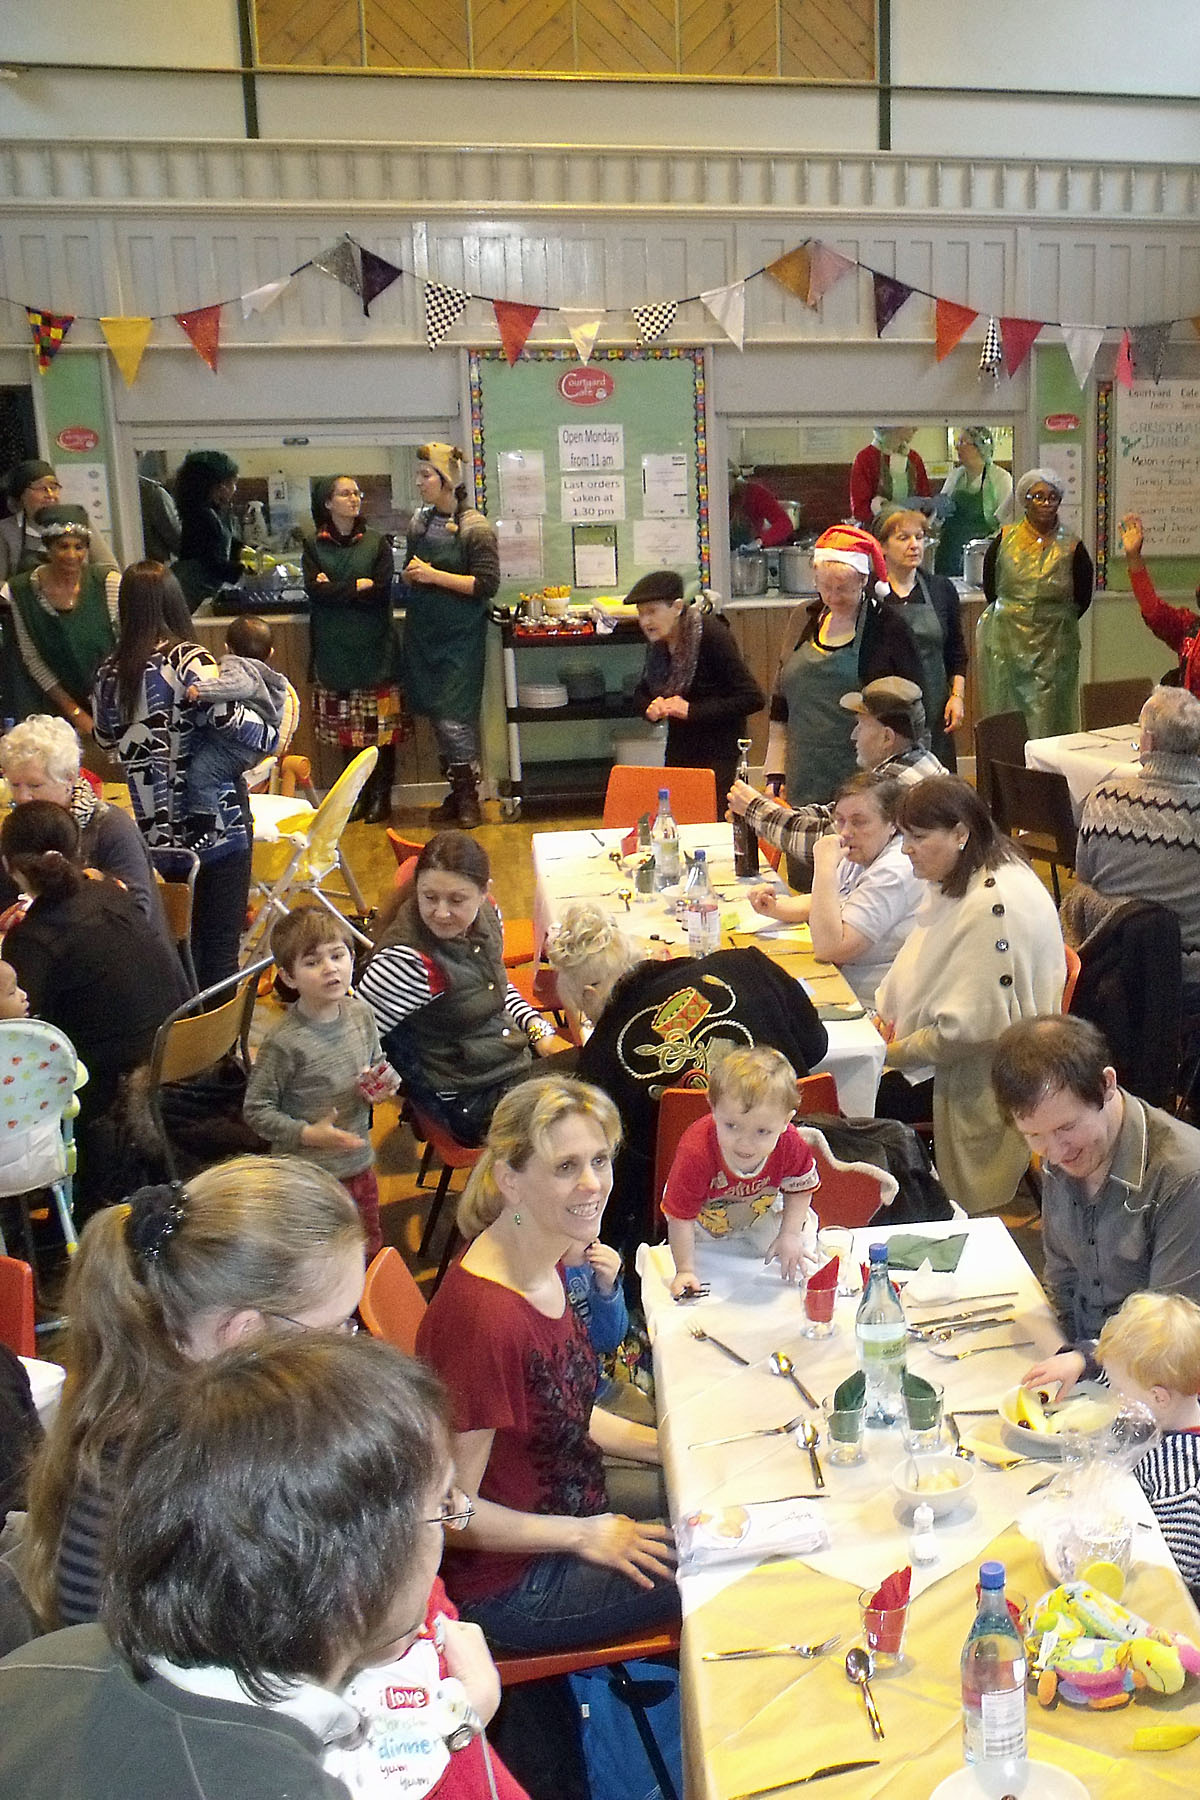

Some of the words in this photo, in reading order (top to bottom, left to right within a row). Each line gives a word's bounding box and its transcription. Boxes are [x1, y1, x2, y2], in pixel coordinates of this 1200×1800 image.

[561, 373, 606, 395] Courtyard
[562, 429, 583, 445] Open
[584, 428, 620, 446] Mondays
[570, 452, 589, 467] from
[591, 453, 600, 467] 11
[602, 455, 614, 467] am
[563, 480, 584, 489] Last
[587, 480, 621, 489] orders
[572, 493, 601, 502] taken
[603, 493, 614, 502] at
[573, 507, 595, 516] 1.30
[597, 508, 615, 517] pm
[389, 1687, 426, 1708] love
